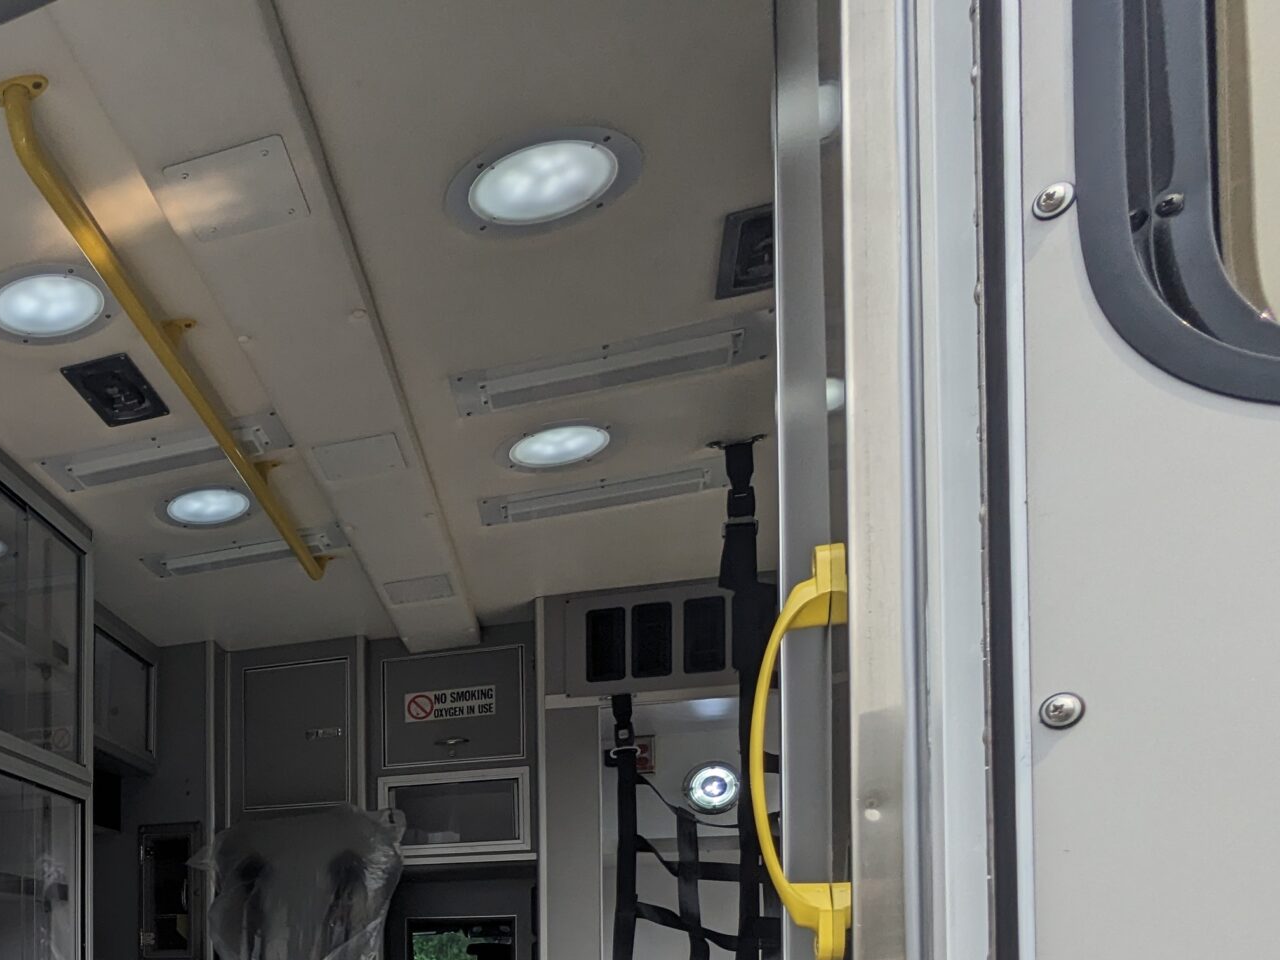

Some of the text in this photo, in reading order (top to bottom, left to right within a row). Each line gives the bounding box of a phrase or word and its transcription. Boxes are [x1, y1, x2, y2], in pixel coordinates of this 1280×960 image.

[434, 688, 493, 705] NO SMOKING
[434, 703, 494, 718] OXYGEN IN USE
